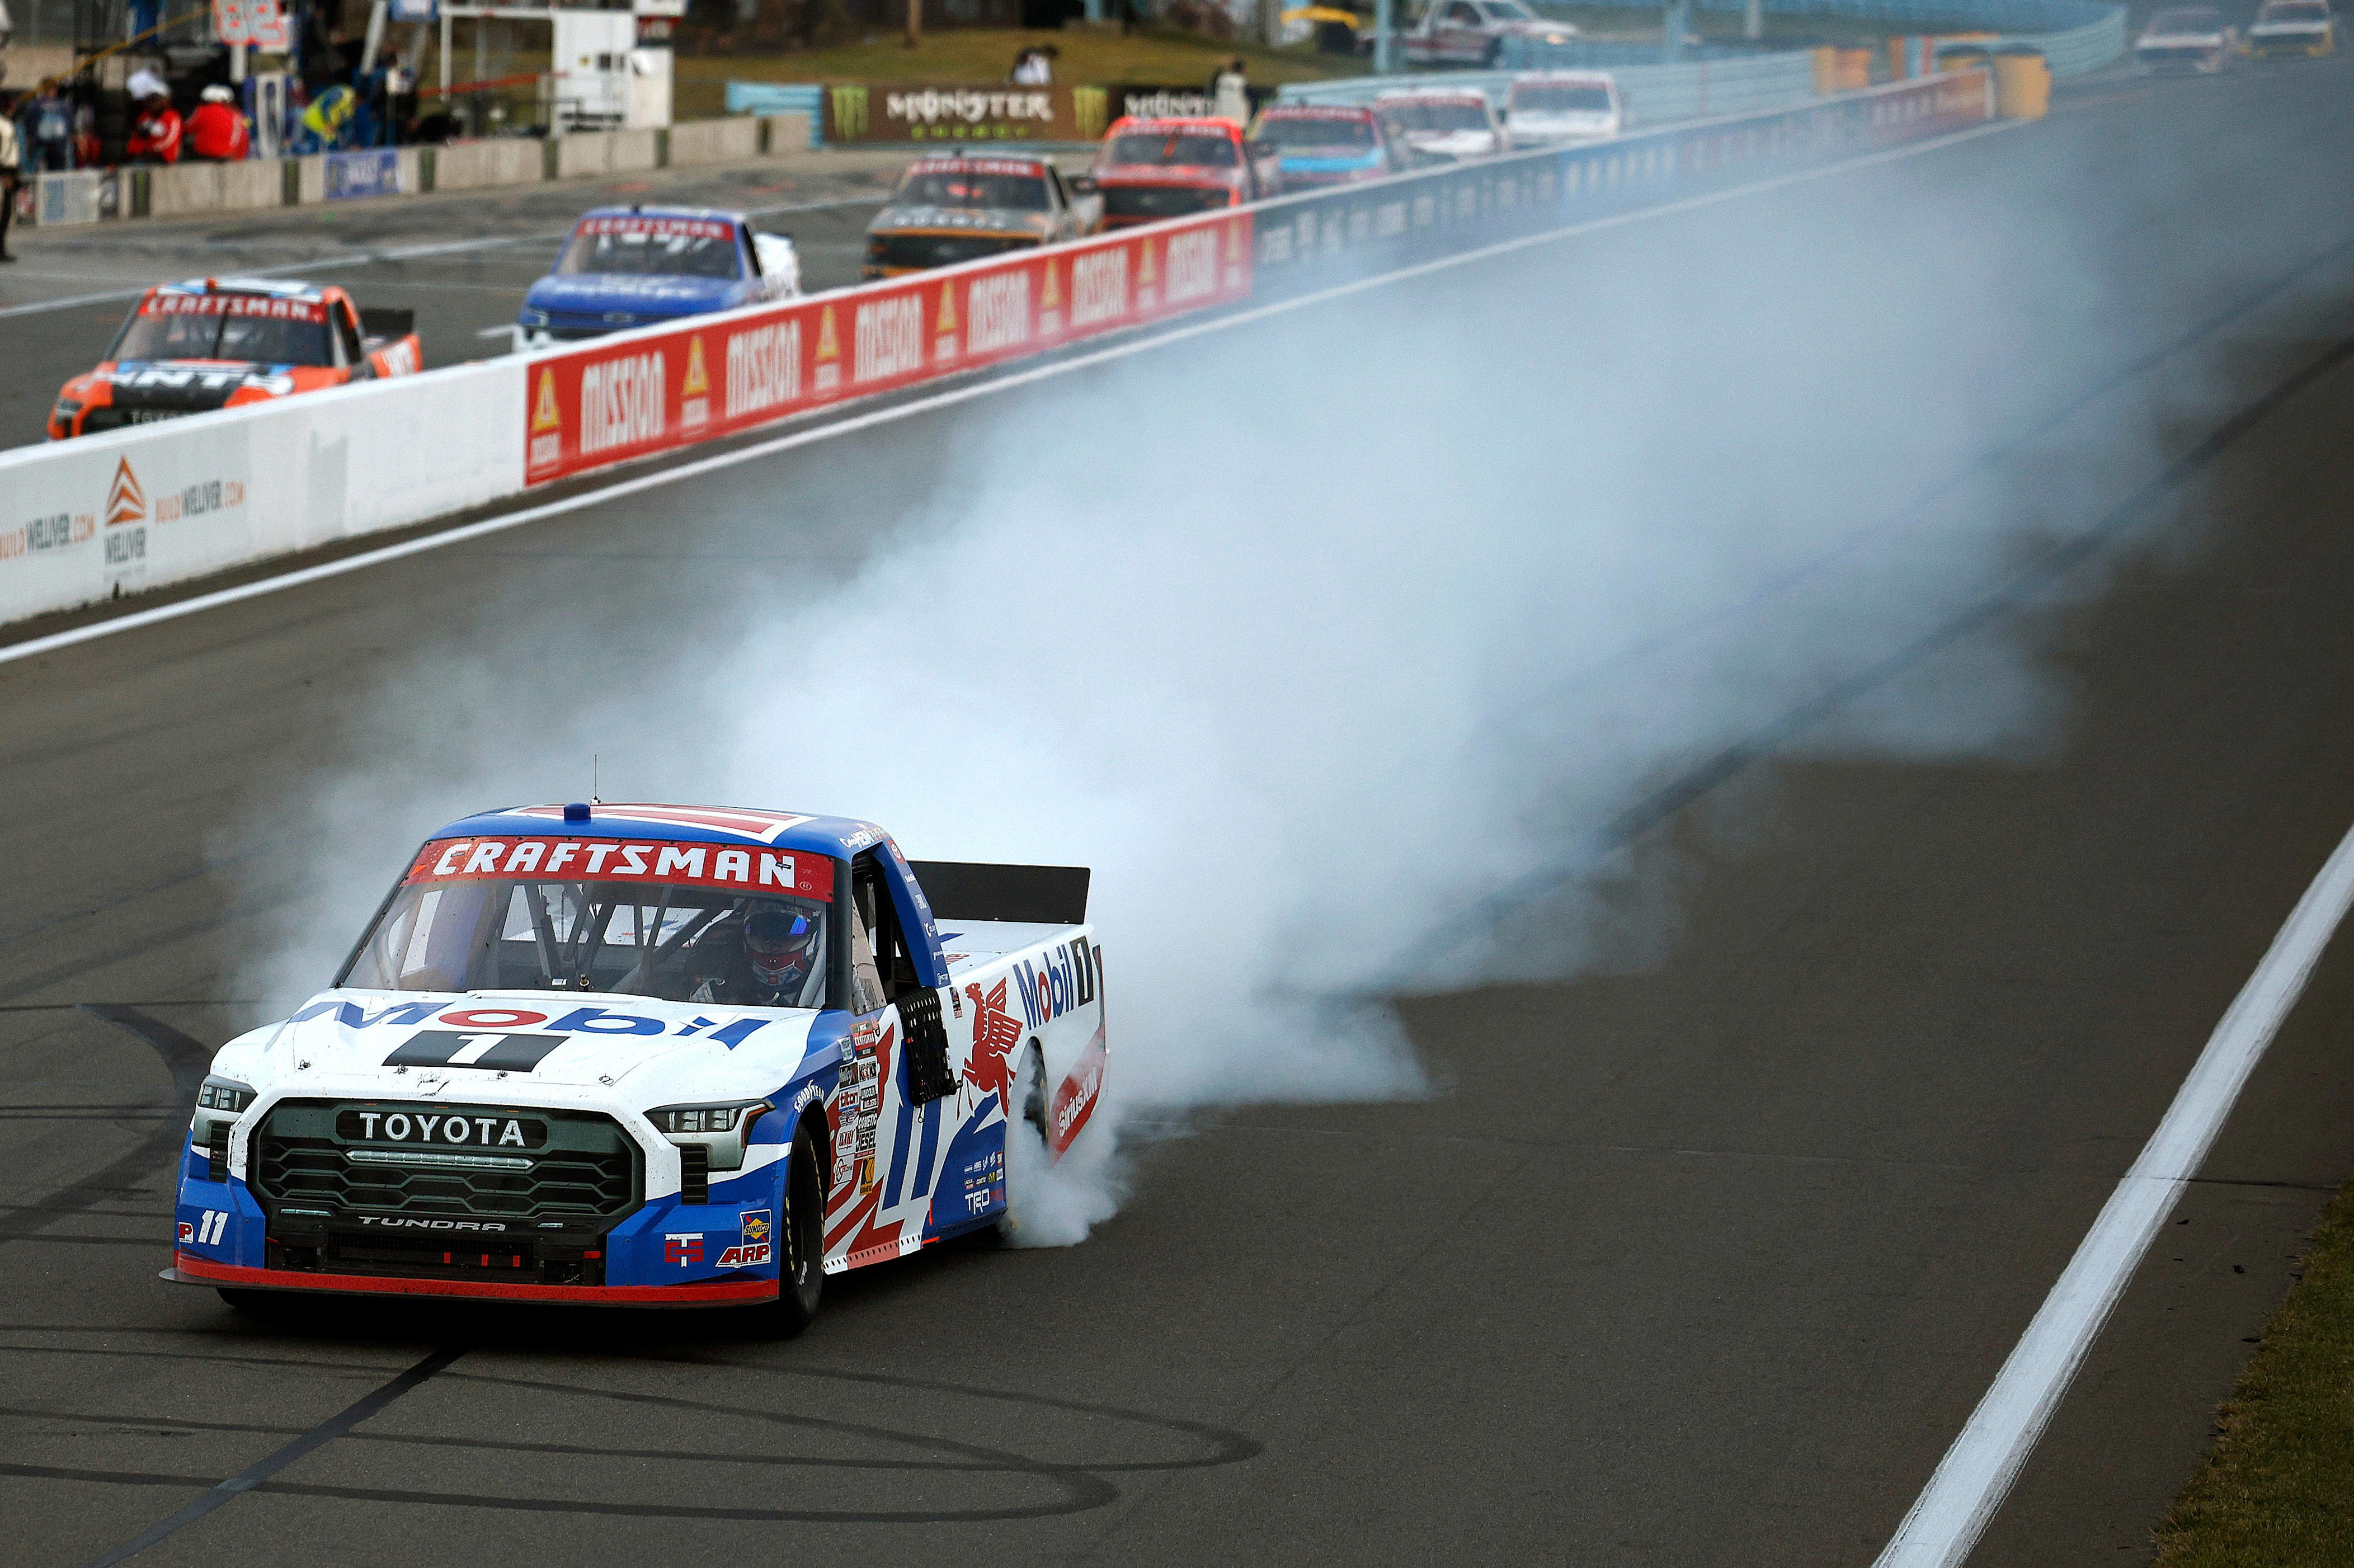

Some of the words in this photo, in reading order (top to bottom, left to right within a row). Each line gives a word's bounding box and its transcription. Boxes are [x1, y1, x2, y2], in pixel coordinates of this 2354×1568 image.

[886, 89, 1053, 124] MONSTER
[726, 319, 801, 419] MISSION
[580, 351, 666, 454] MISSION
[432, 841, 795, 889] CRAFTSMAN
[1012, 944, 1074, 1030] Mobil
[286, 1001, 773, 1051] Mobil
[447, 1033, 509, 1065] 1
[794, 1079, 825, 1113] GOODYEAR
[359, 1113, 525, 1147] TOYOTA
[856, 1131, 876, 1152] JESEL
[965, 1188, 990, 1215] TRD
[197, 1209, 229, 1245] 11
[359, 1216, 506, 1231] TUNDRA
[745, 1223, 770, 1235] SUNOCO
[719, 1245, 770, 1263] ARP
